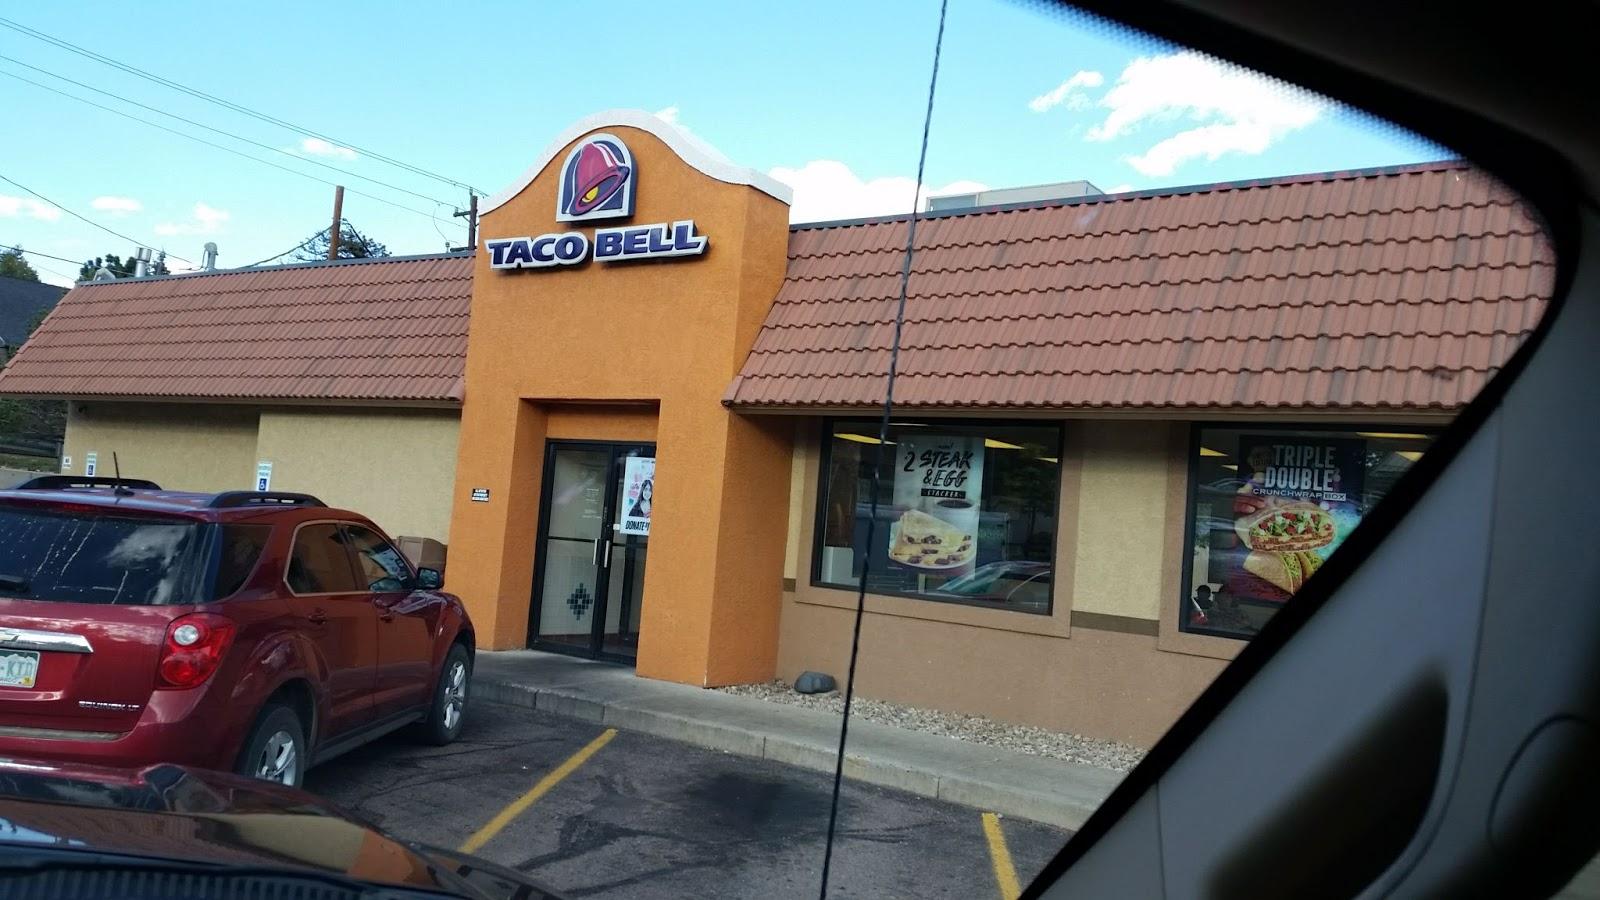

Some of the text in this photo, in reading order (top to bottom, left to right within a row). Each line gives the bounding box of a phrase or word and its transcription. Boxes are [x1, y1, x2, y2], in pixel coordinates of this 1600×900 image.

[487, 224, 702, 265] TACO BELL
[903, 450, 973, 472] 2 STEAK
[1273, 445, 1336, 468] TRIPLE
[1265, 467, 1334, 491] DOUBLE
[1253, 488, 1323, 499] CRUNCHWRAP
[625, 521, 645, 531] DONATE
